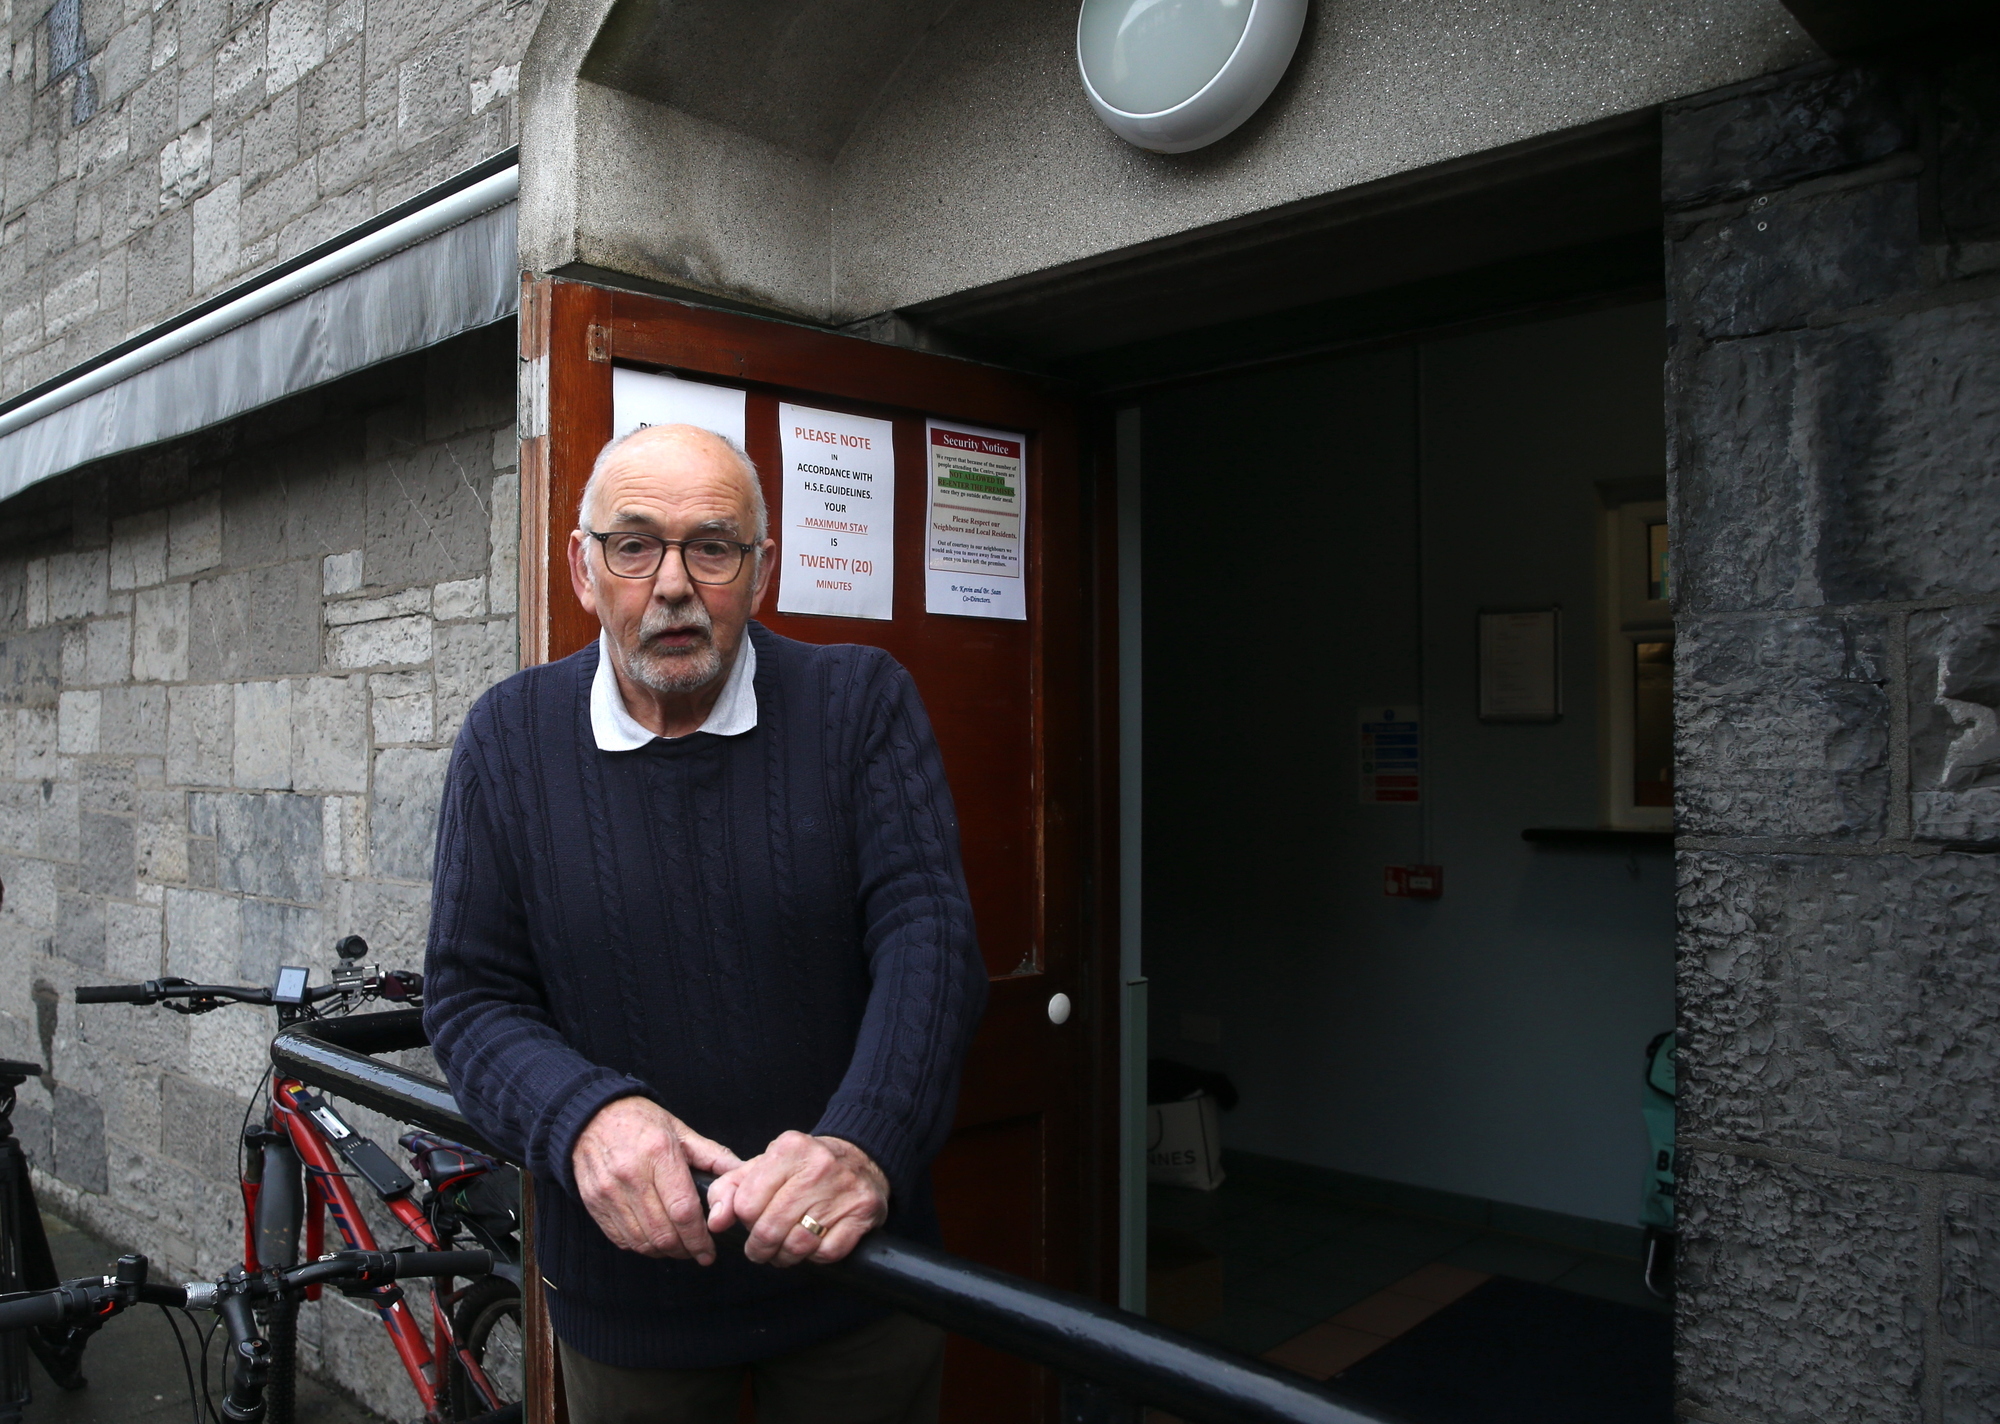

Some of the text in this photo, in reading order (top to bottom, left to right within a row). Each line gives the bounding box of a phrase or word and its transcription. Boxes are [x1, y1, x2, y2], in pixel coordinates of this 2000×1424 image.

[795, 427, 871, 450] PLEASE NOTE
[943, 434, 1009, 454] Security Notice
[797, 463, 872, 482] ACCORDANCE WITH
[952, 464, 972, 472] attending
[938, 478, 970, 489] RE-ENTER
[971, 483, 983, 491] THE
[949, 470, 963, 478] NOT
[965, 472, 995, 484] ALLOWED
[804, 482, 872, 499] H.S.E.GUIDELINES.
[824, 502, 846, 513] YOUR
[805, 517, 868, 533] MAXIMUM STAY
[952, 515, 969, 525] Please
[970, 518, 990, 528] Respect
[933, 523, 1017, 540] Neighbours and Local Residents.
[830, 538, 838, 546] IS
[952, 542, 969, 550] courtesy
[983, 545, 1006, 553] neighbours
[800, 554, 873, 576] TWENTY (20)
[816, 579, 852, 591] MINUTES
[307, 1164, 403, 1338] GIAT
